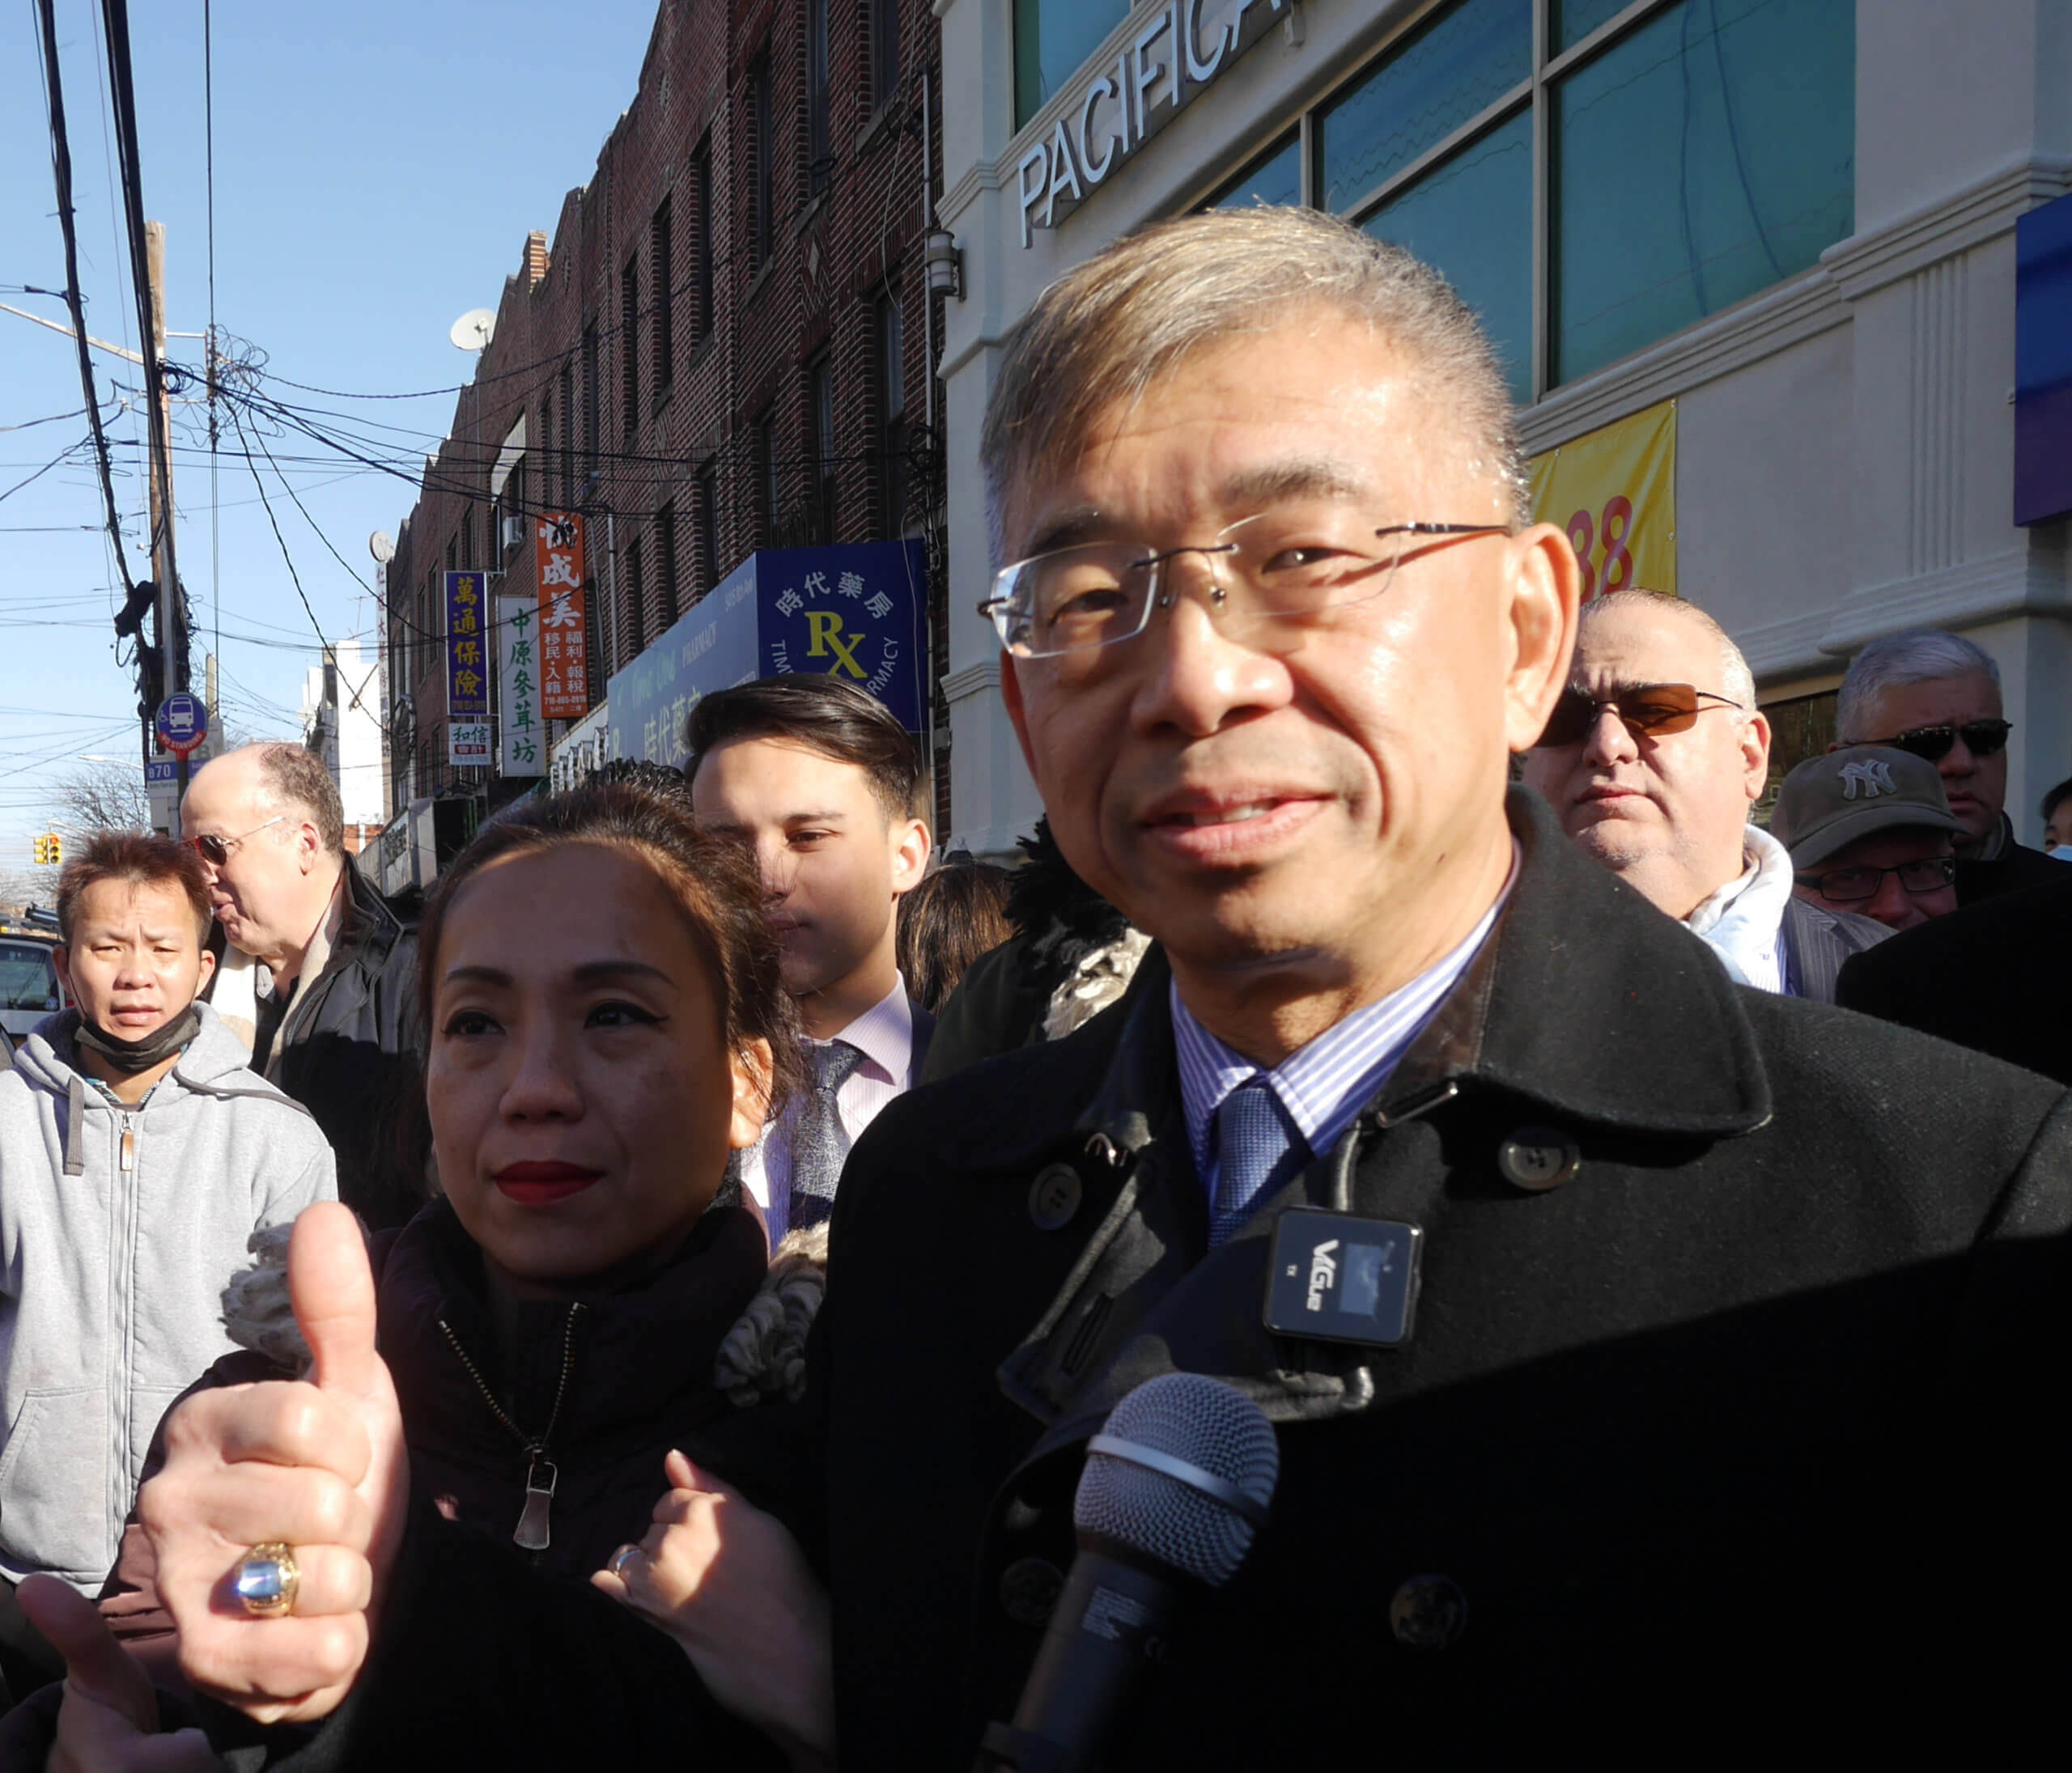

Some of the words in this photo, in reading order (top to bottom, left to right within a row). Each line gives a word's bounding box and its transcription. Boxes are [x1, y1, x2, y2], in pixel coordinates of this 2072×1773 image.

[775, 571, 894, 619] 時代藥房
[453, 577, 482, 697] 萬通保險
[771, 639, 794, 674] TIM
[866, 637, 898, 695] RMACY
[171, 732, 202, 749] STANDING
[452, 726, 488, 744] 和信
[148, 764, 172, 778] B70
